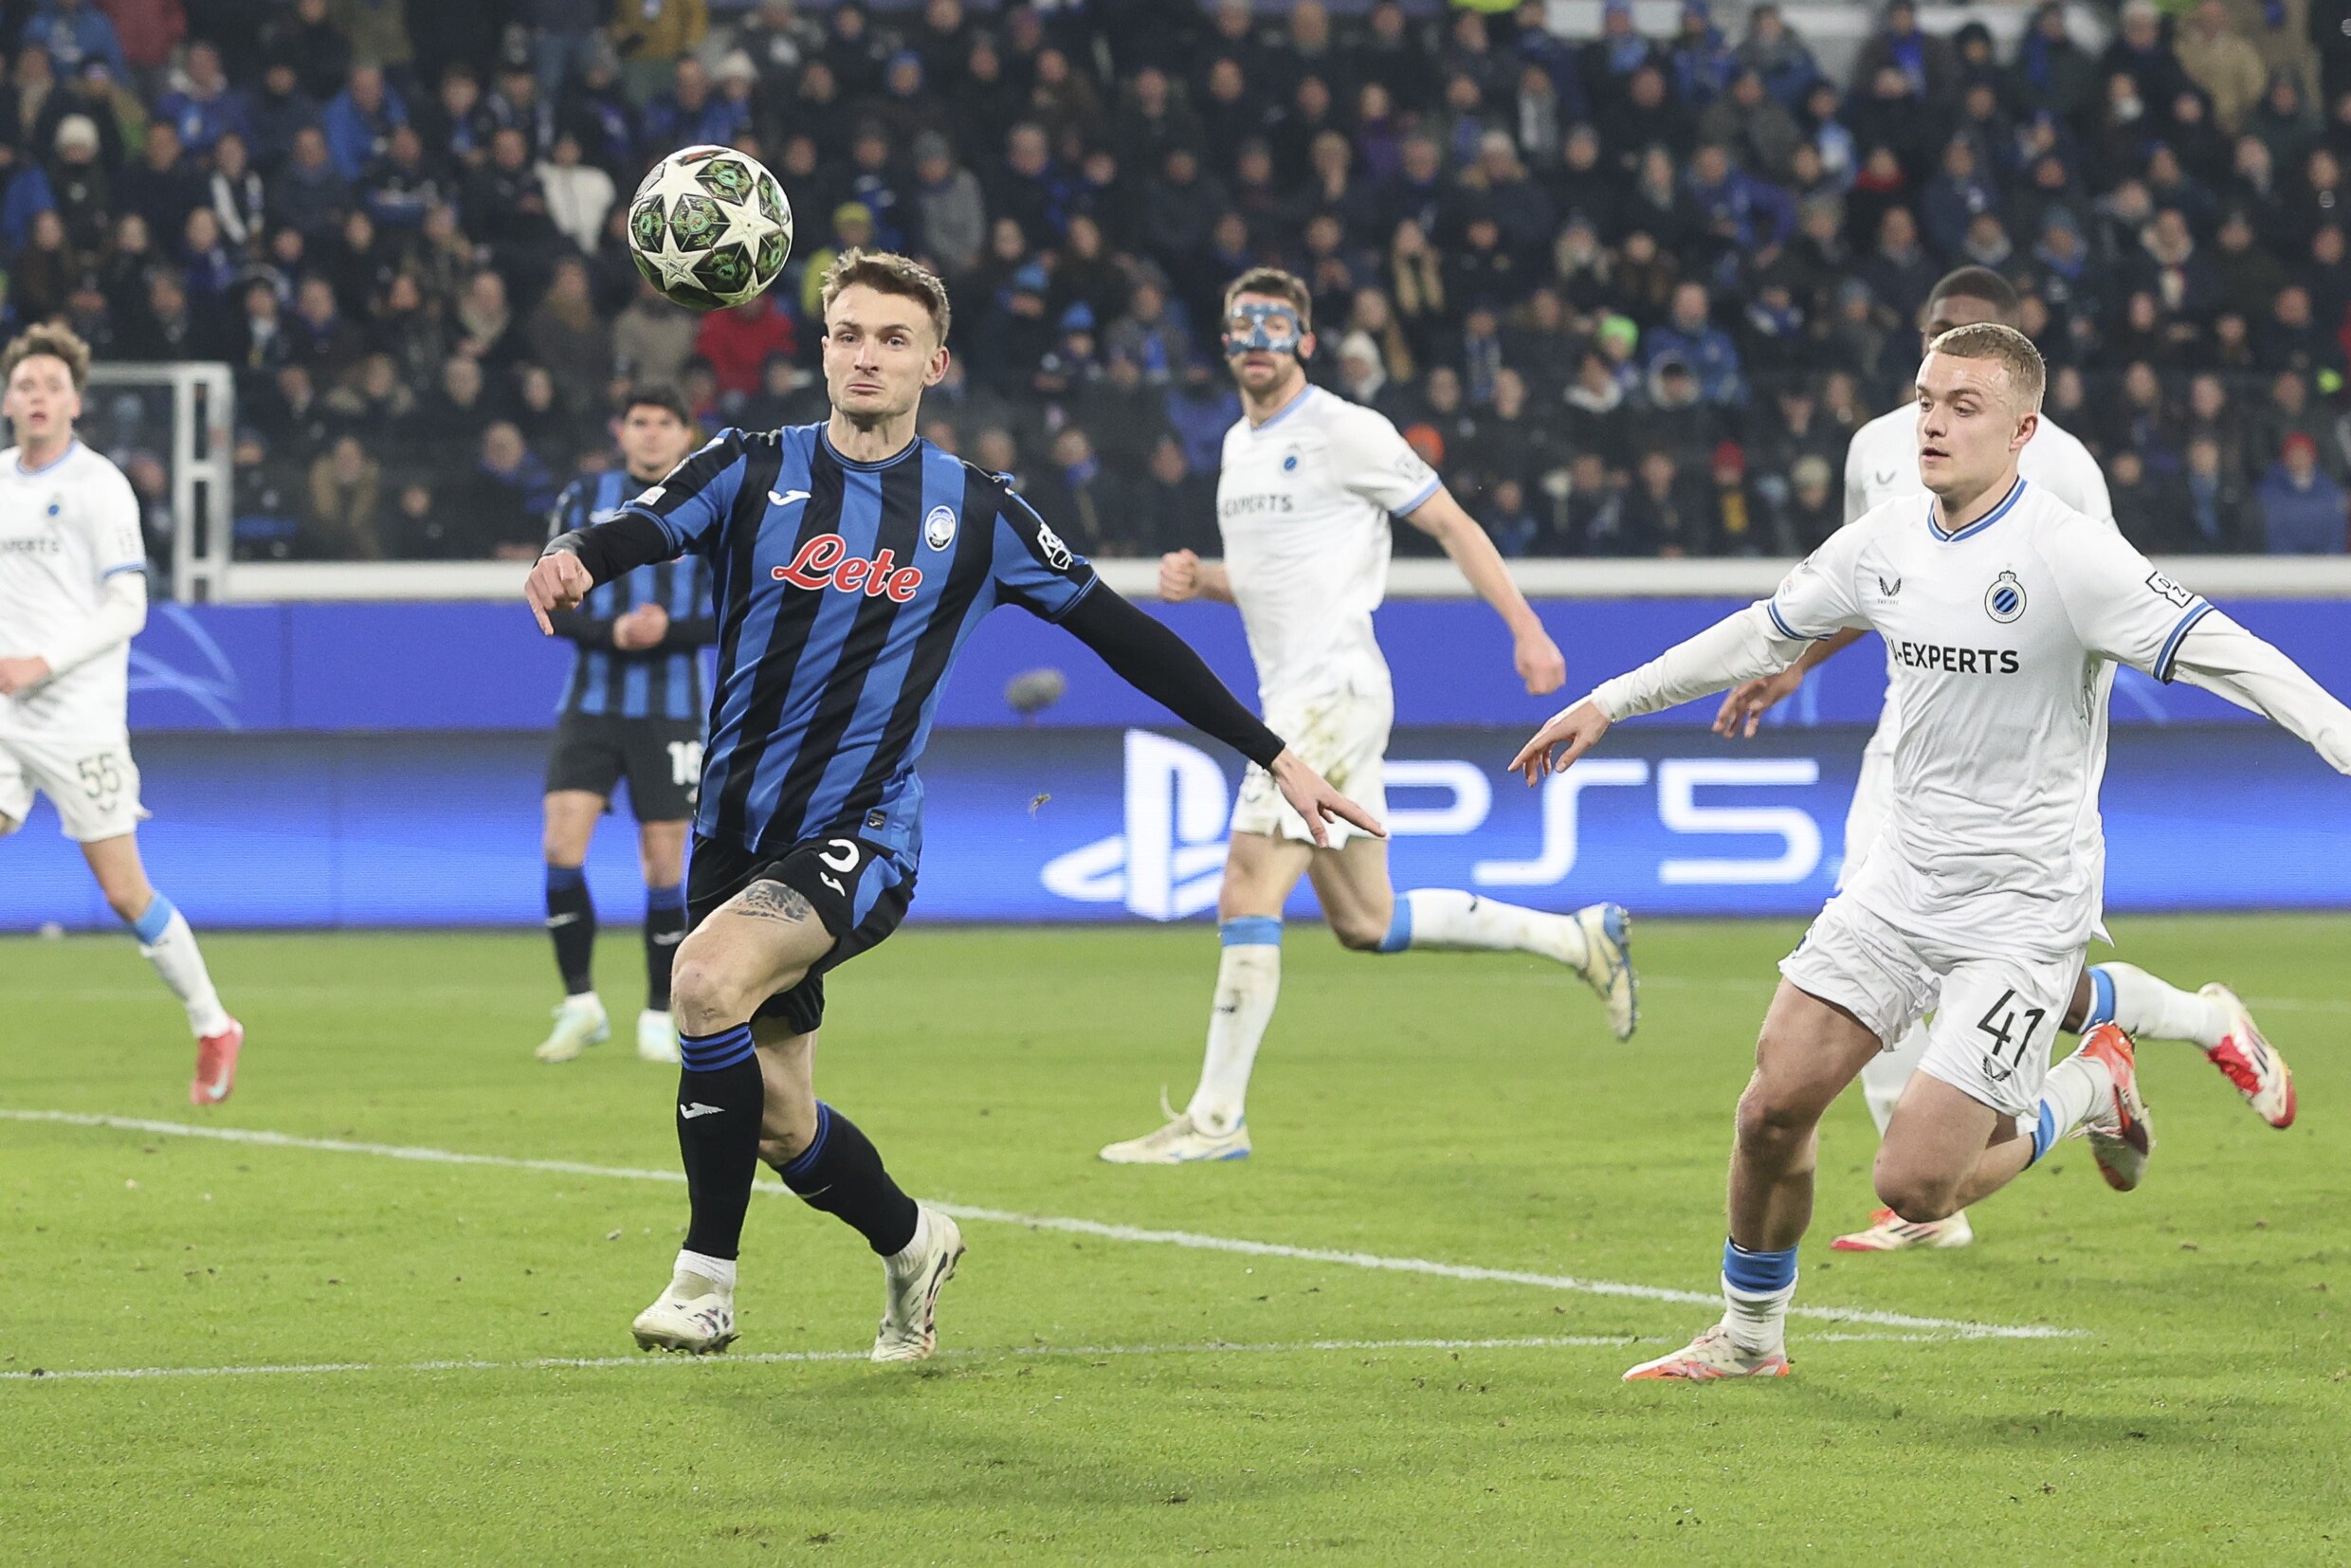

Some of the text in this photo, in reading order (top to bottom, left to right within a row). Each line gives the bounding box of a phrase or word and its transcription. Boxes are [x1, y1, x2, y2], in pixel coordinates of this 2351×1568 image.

[771, 533, 923, 603] Lete
[77, 752, 121, 799] 55
[1383, 759, 1823, 886] PS5
[1977, 988, 2046, 1068] 41
